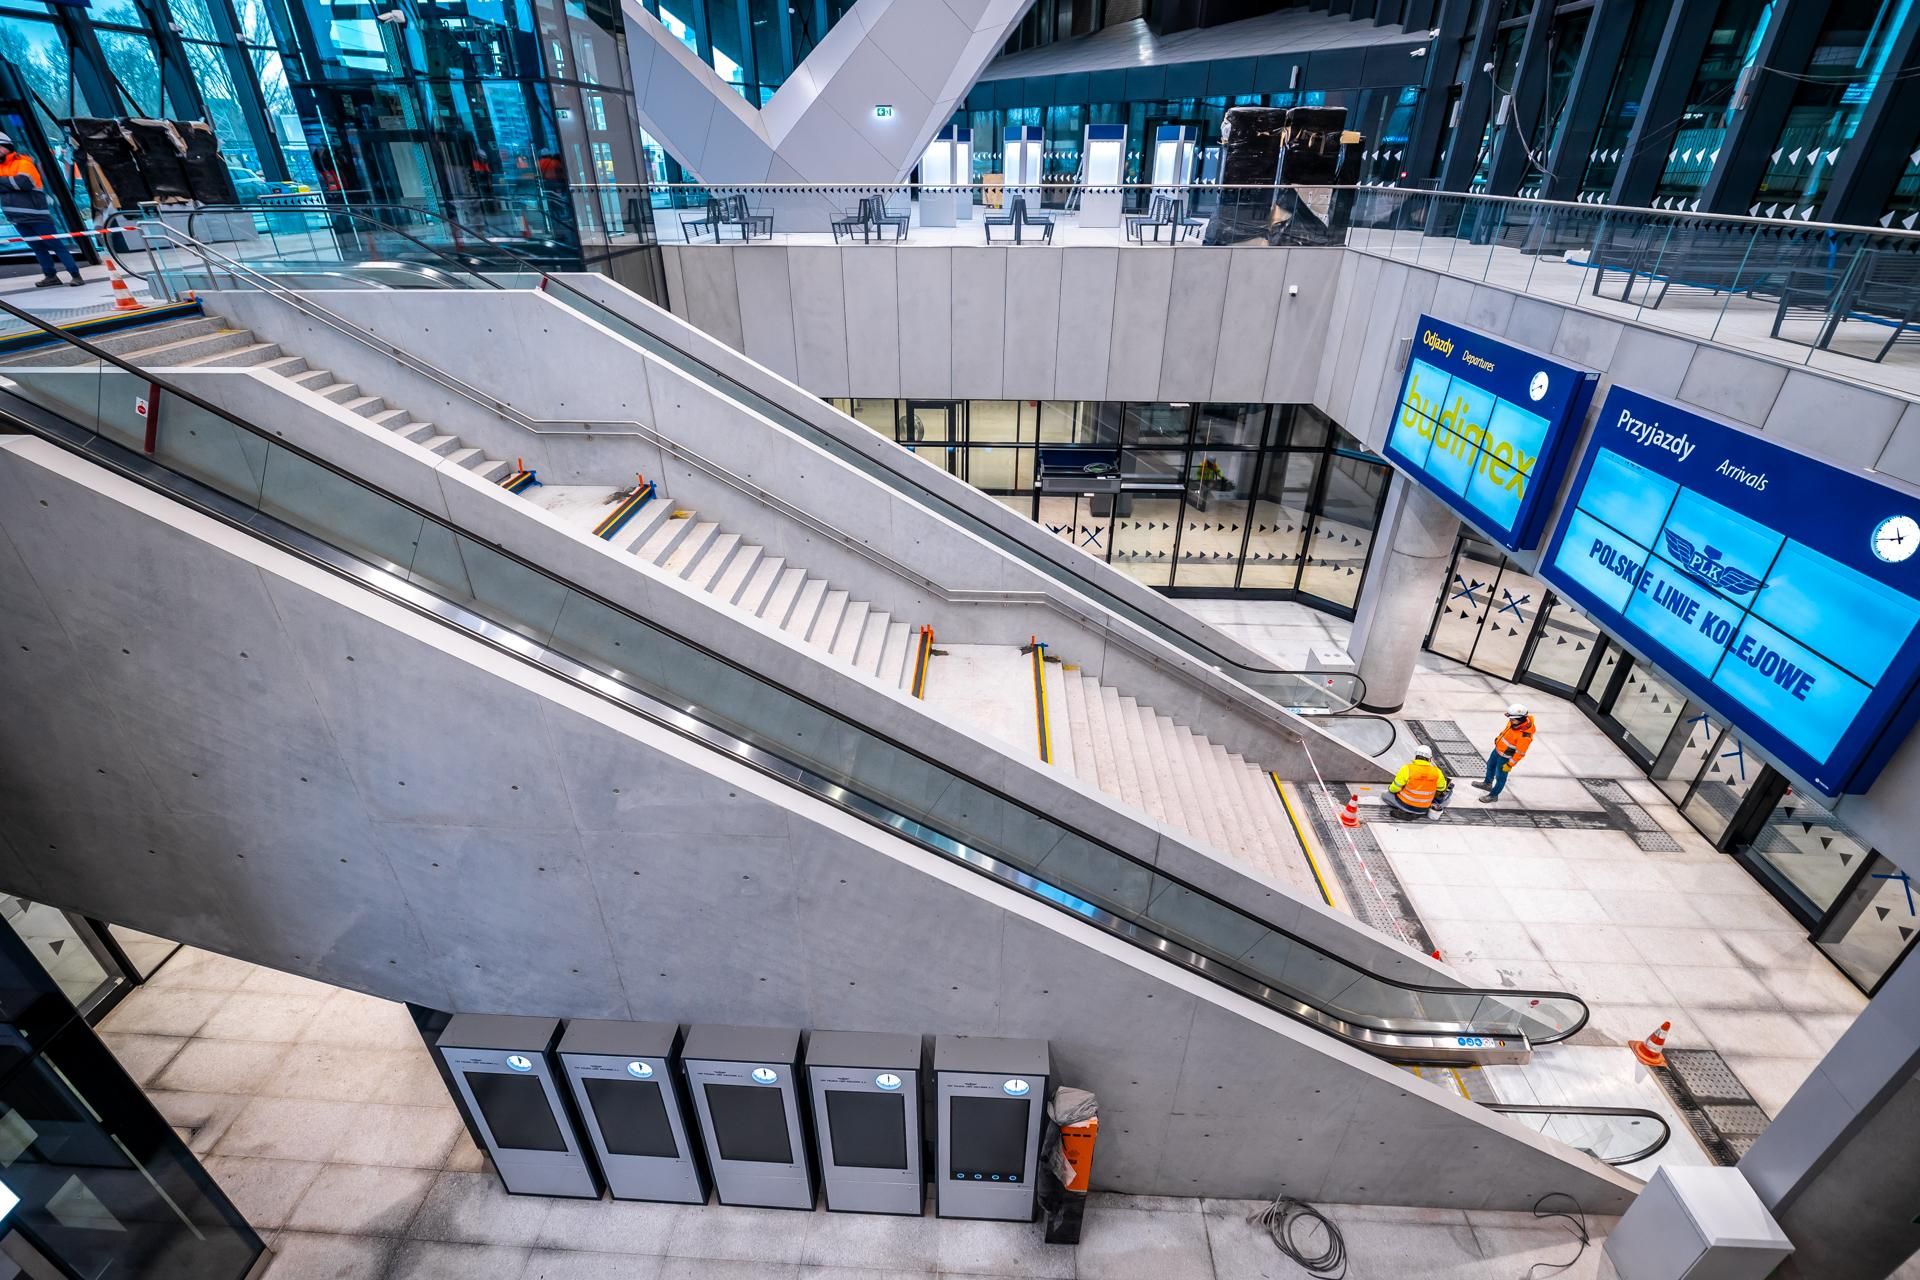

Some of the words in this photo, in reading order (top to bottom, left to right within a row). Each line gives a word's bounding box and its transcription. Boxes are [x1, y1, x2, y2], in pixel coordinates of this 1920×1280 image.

[1424, 330, 1454, 357] Odjazdy
[1463, 351, 1495, 372] Departures
[1402, 375, 1536, 500] budimex
[1617, 409, 1696, 462] Przyjazdy
[1716, 459, 1769, 492] Arrivals
[1690, 554, 1722, 582] PLK
[1590, 539, 1652, 592] POLSKIE
[1652, 580, 1701, 626] LINIE
[1701, 611, 1815, 701] KOLEJOWE
